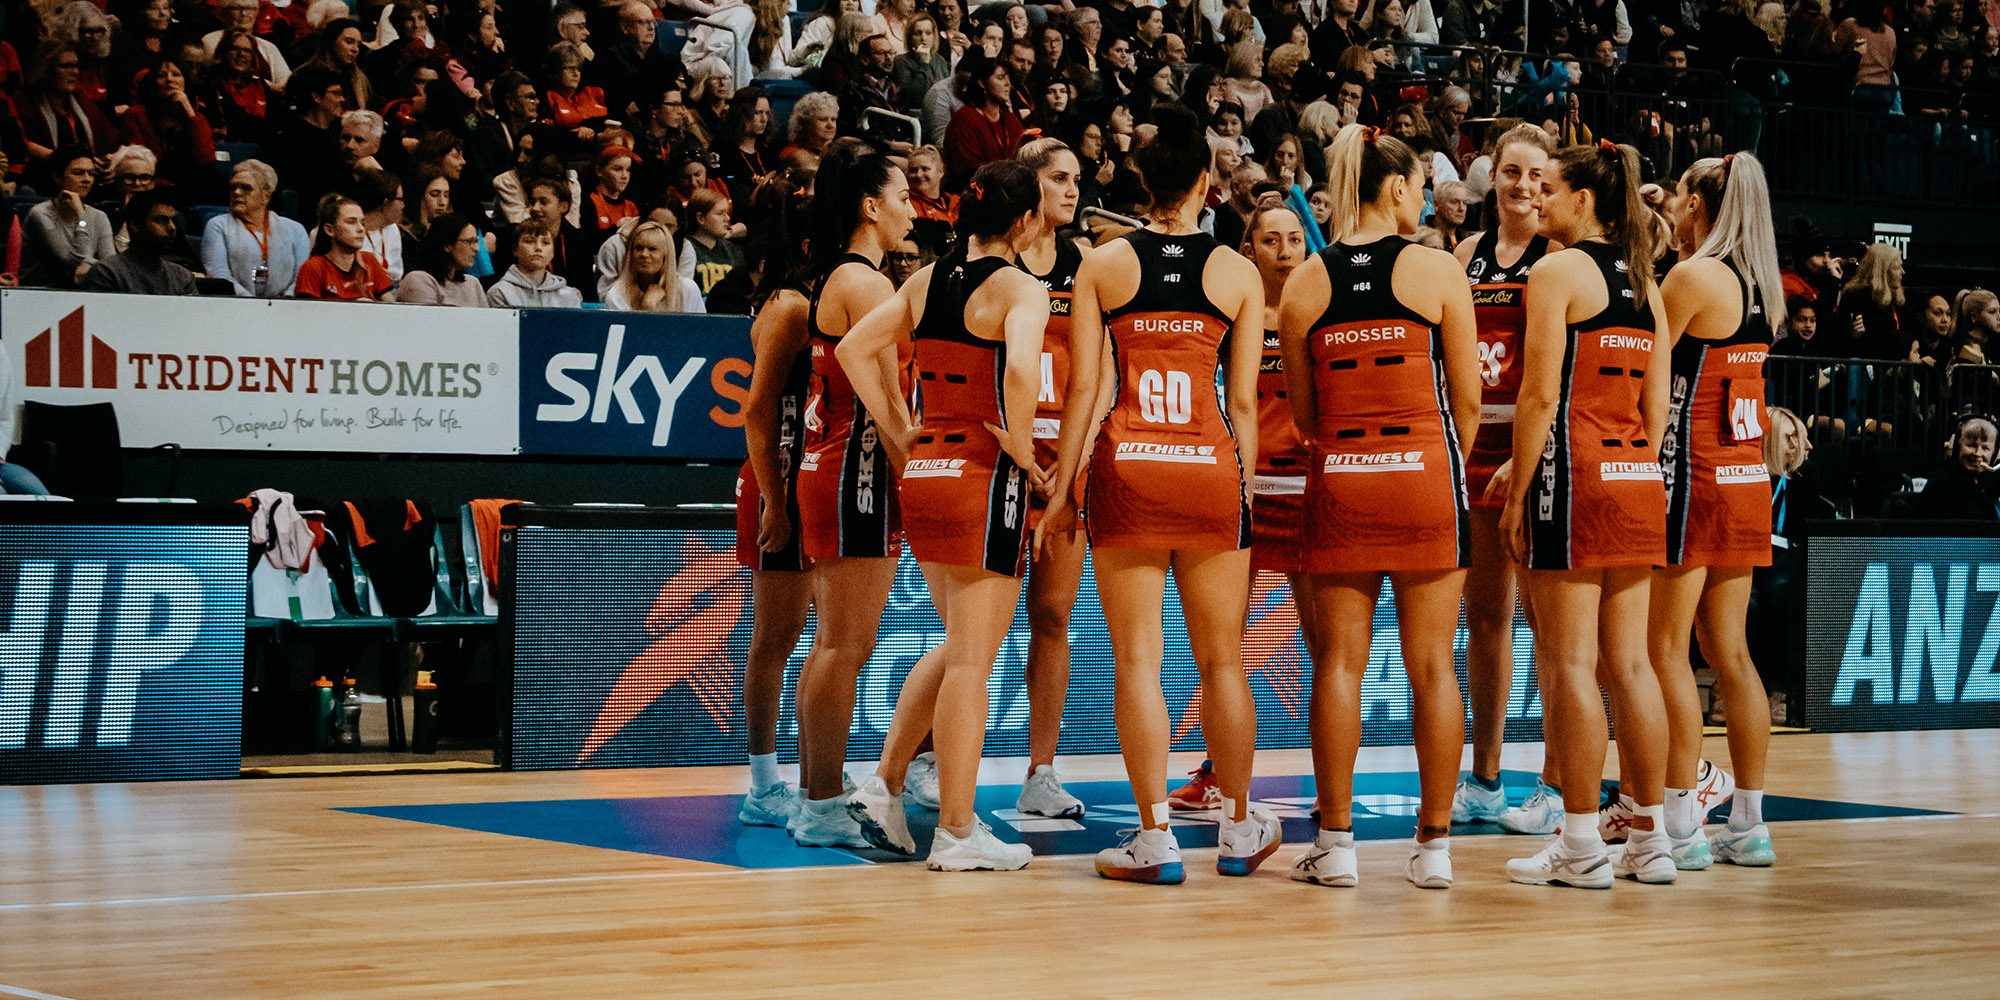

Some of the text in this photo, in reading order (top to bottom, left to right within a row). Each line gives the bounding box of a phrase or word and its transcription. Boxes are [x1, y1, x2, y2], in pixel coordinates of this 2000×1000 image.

[1494, 291, 1513, 303] Oil
[1050, 299, 1069, 313] Oil
[1134, 319, 1204, 333] BURGER
[1324, 326, 1407, 346] PROSSER
[1138, 369, 1192, 425] GD
[212, 408, 288, 439] Designed
[292, 408, 316, 434] for
[366, 406, 408, 429] Built
[412, 407, 434, 432] for
[1116, 442, 1197, 456] RITCHIES
[905, 459, 951, 470] ITCHIES
[1325, 451, 1402, 465] RITCHIES
[1601, 462, 1657, 473] RITCHIES
[1716, 464, 1763, 476] RITCHIES
